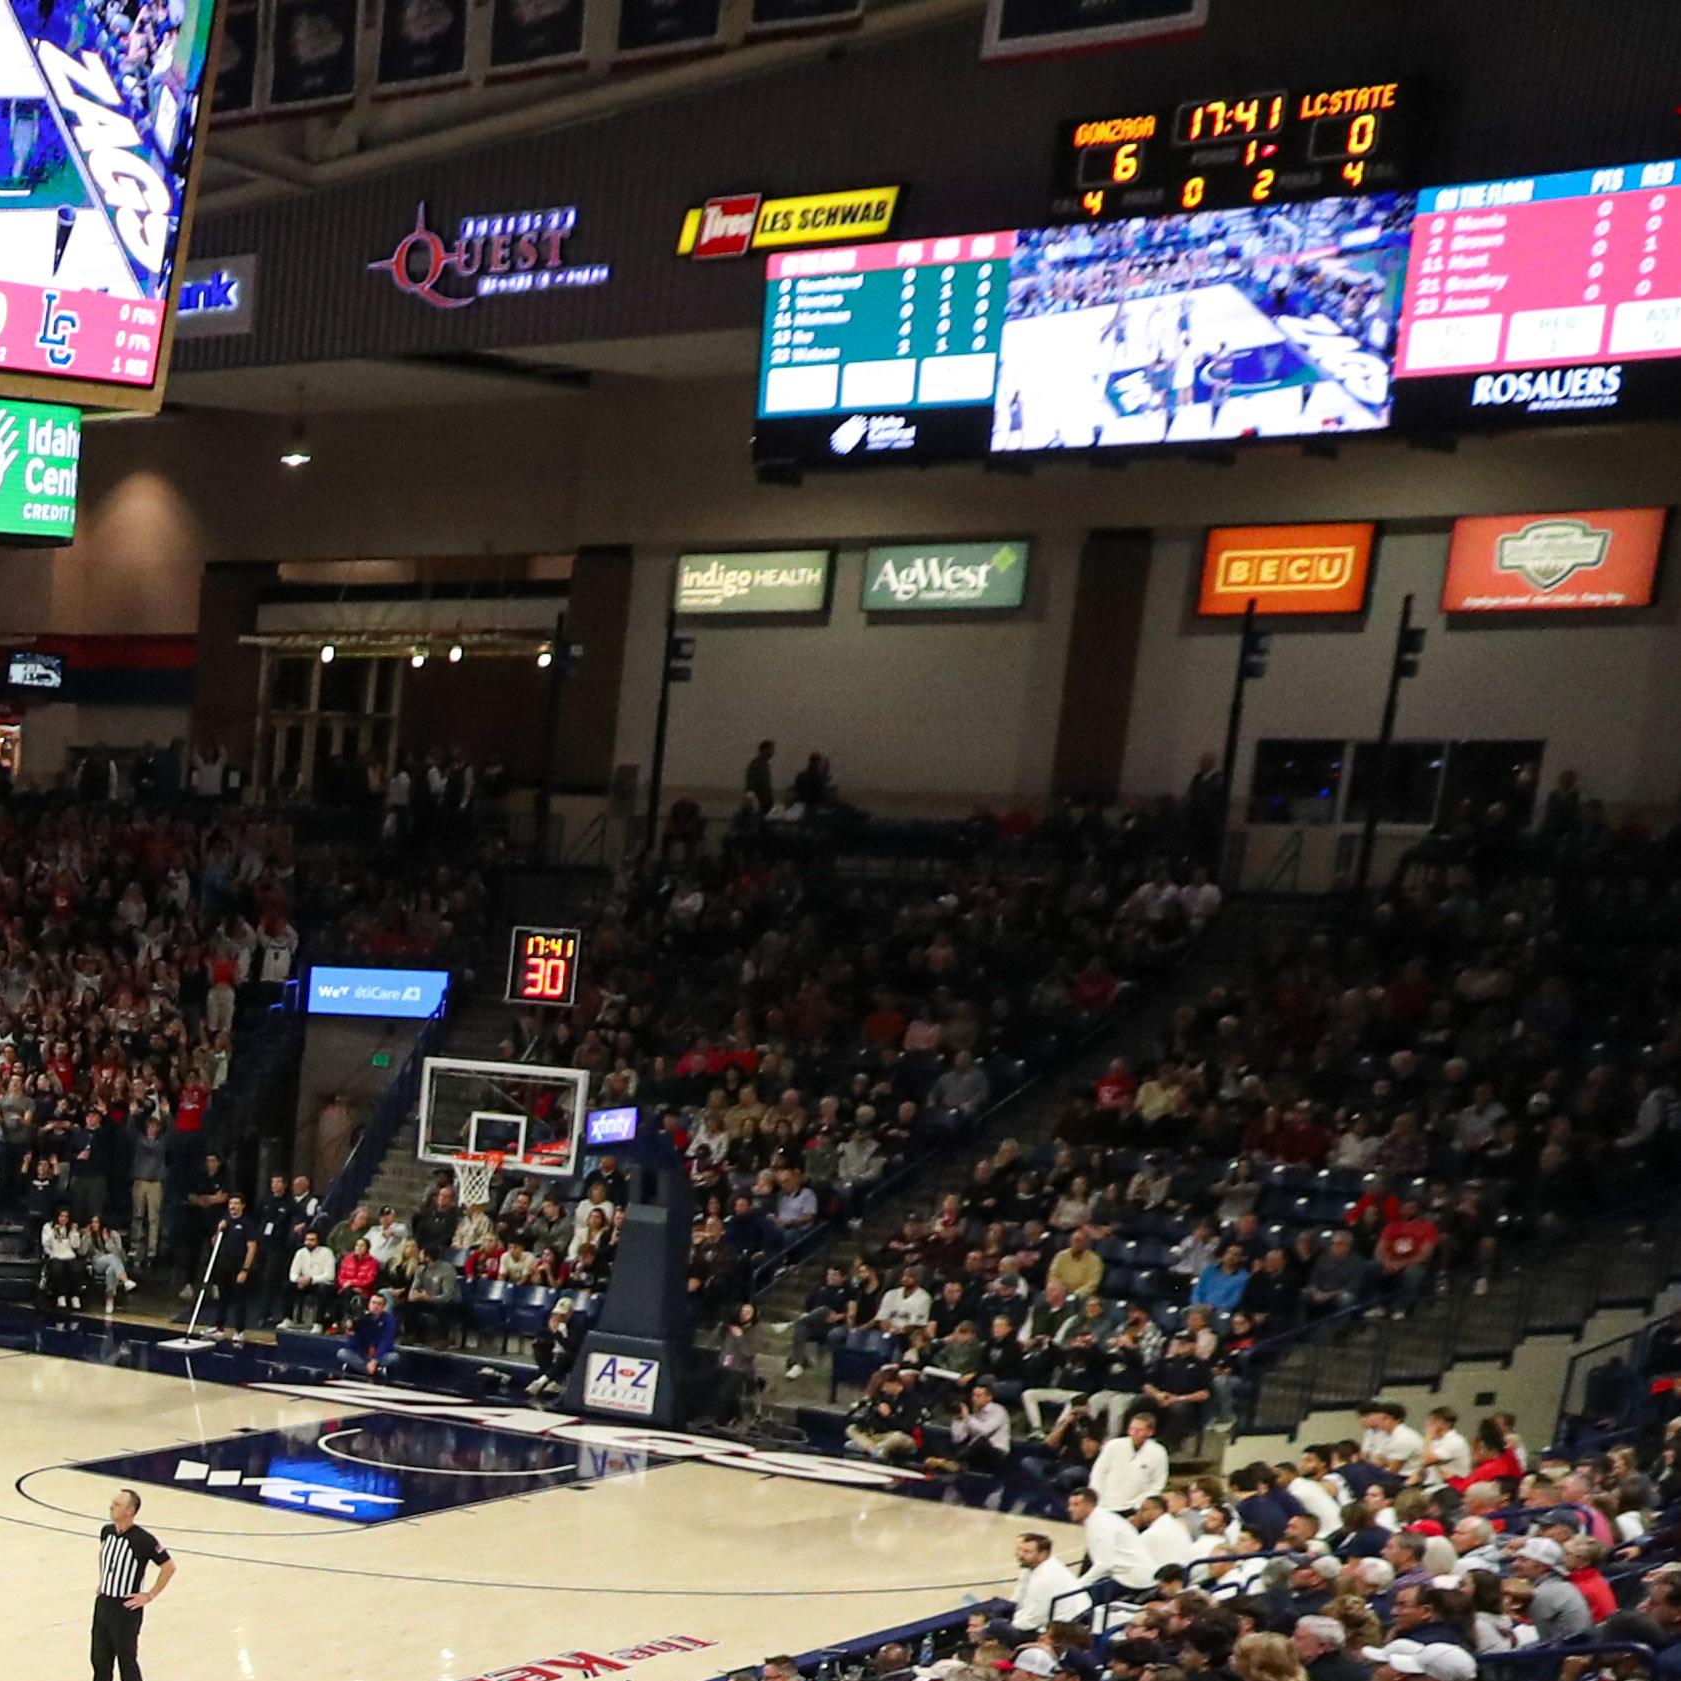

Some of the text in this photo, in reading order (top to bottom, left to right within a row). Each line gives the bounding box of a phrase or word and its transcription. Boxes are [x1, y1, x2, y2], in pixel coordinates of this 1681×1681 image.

[1074, 116, 1156, 147] GONZAGA
[1189, 97, 1282, 140] 17:41
[1347, 114, 1376, 155] 0
[1112, 144, 1138, 182] 6
[1342, 161, 1364, 186] 4
[1182, 176, 1205, 208] 0
[1252, 169, 1274, 201] 2
[760, 202, 886, 234] LES SCHWAB
[1083, 190, 1104, 216] 4
[1598, 194, 1665, 217] 0 0
[1427, 237, 1443, 254] 2
[1594, 220, 1610, 237] 0
[1645, 214, 1662, 232] 0
[1420, 239, 1607, 273] 11 0
[1416, 256, 1655, 294] 21 0 0
[119, 304, 131, 322] 0
[1413, 279, 1651, 315] 23 0 0
[115, 330, 127, 347] 0
[111, 357, 121, 373] 1
[1472, 366, 1621, 406] ROSAUERS
[681, 561, 823, 598] indigo HEALTH
[870, 557, 994, 602] AgWest
[1226, 549, 1346, 586] BECU
[525, 936, 574, 957] 17:41
[523, 957, 566, 997] 30
[590, 1113, 632, 1141] xfinity
[609, 1634, 719, 1662] The
